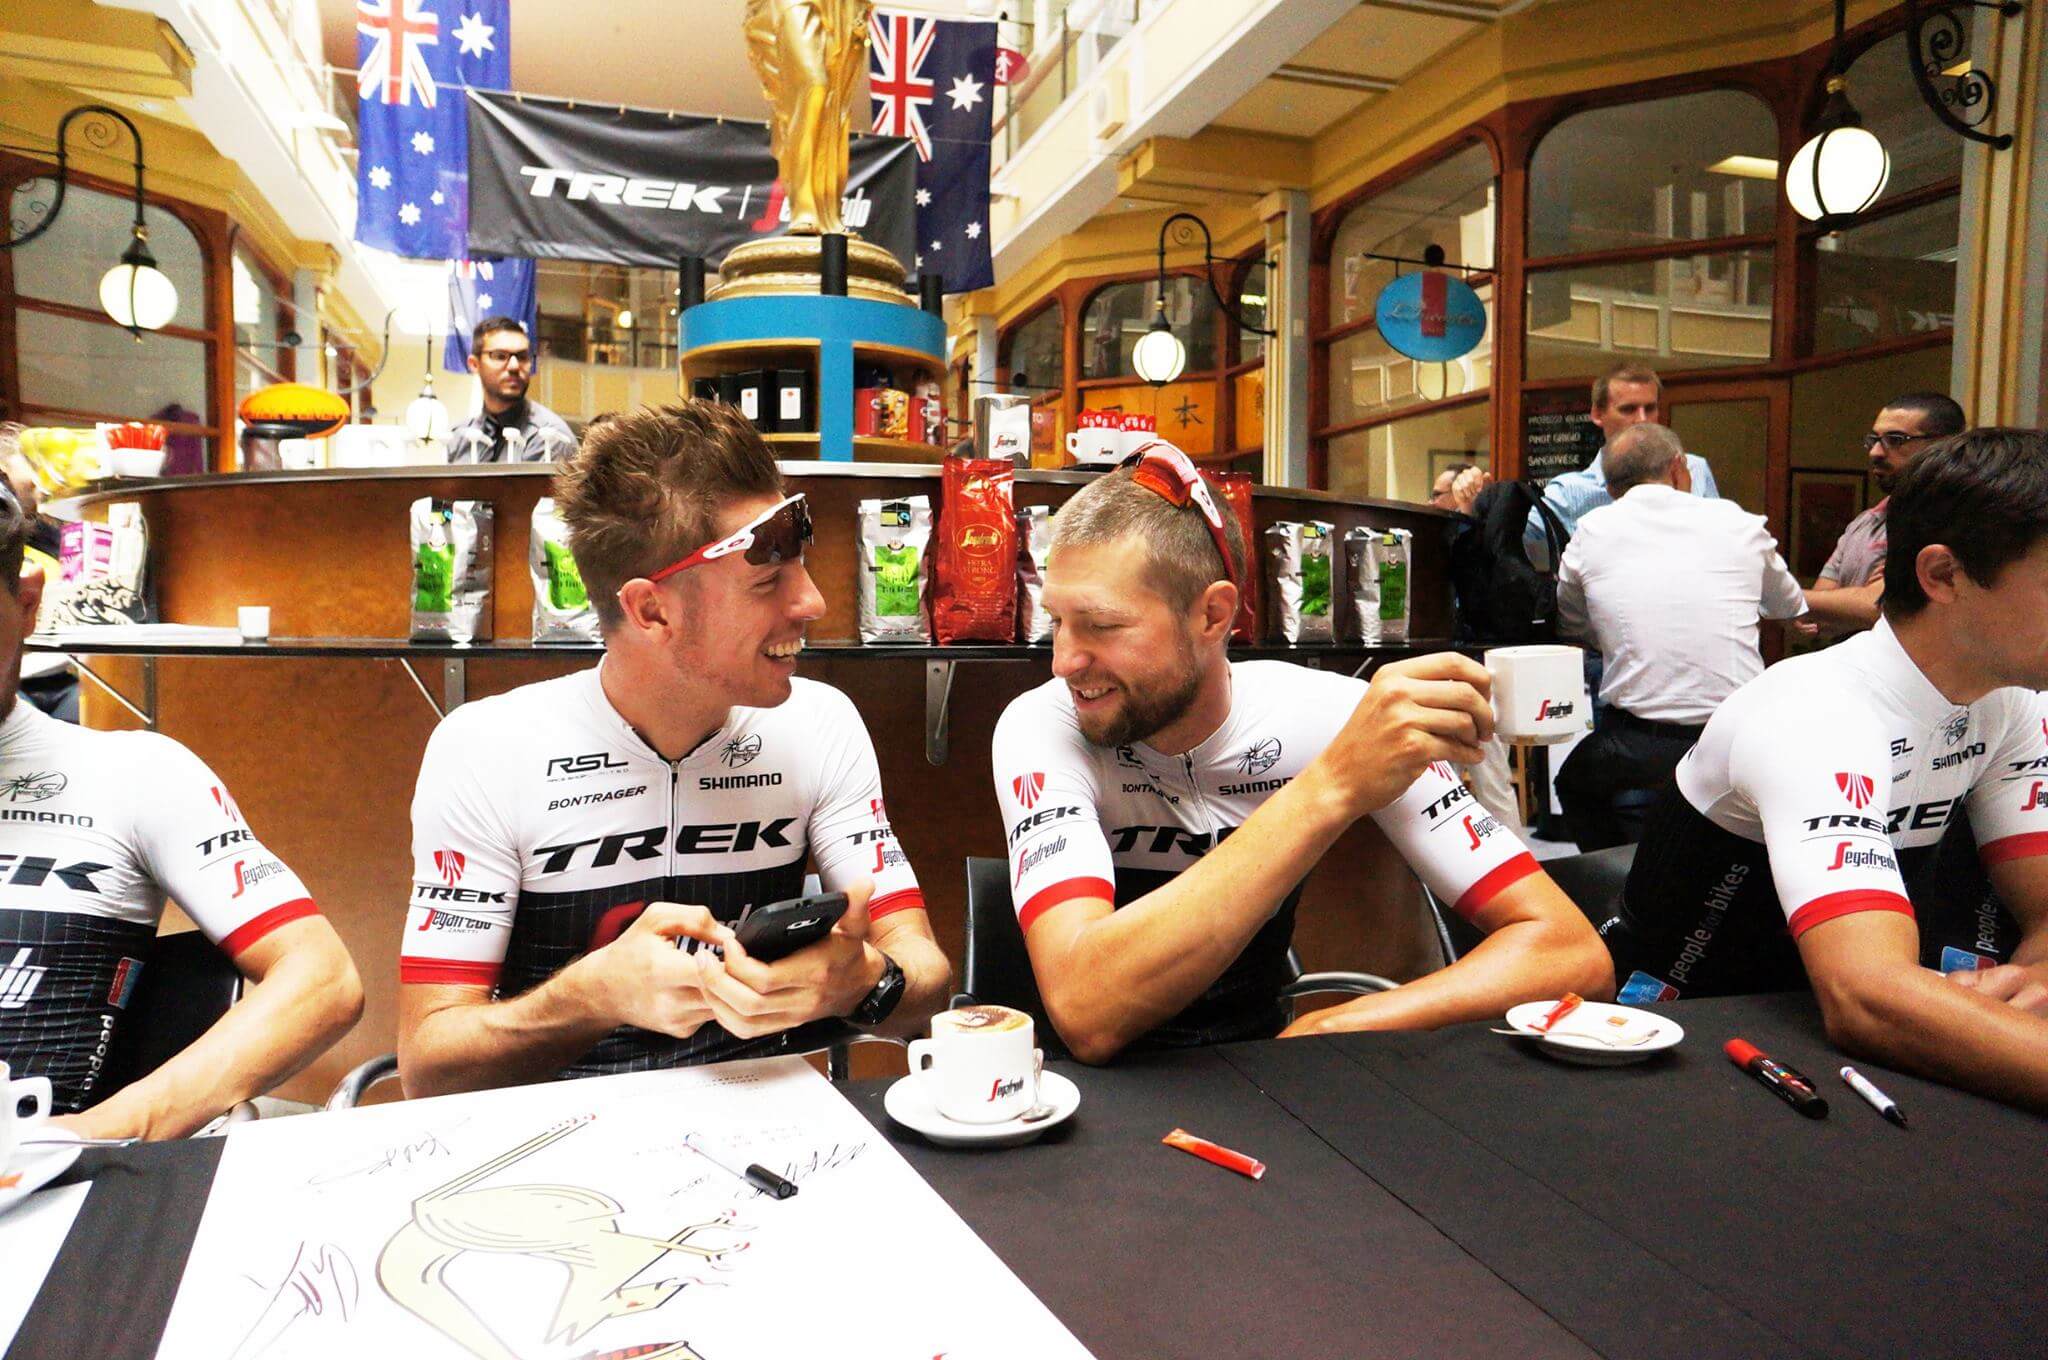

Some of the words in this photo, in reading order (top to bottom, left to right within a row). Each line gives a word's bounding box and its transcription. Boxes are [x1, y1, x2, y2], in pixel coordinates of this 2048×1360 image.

[520, 166, 730, 214] TREK
[1890, 737, 1914, 757] SL
[547, 752, 629, 776] RSL
[2009, 756, 2048, 771] TR
[699, 772, 782, 790] SHIMANO
[1219, 776, 1294, 796] SHIMA
[548, 786, 647, 810] BONTRAGER
[1421, 784, 1471, 820] TRE
[1, 809, 93, 828] IMANO
[1009, 806, 1081, 850] TREK
[196, 829, 254, 856] TRE
[532, 817, 797, 874] TREK
[1112, 825, 1241, 857] TR
[417, 885, 507, 904] TREK
